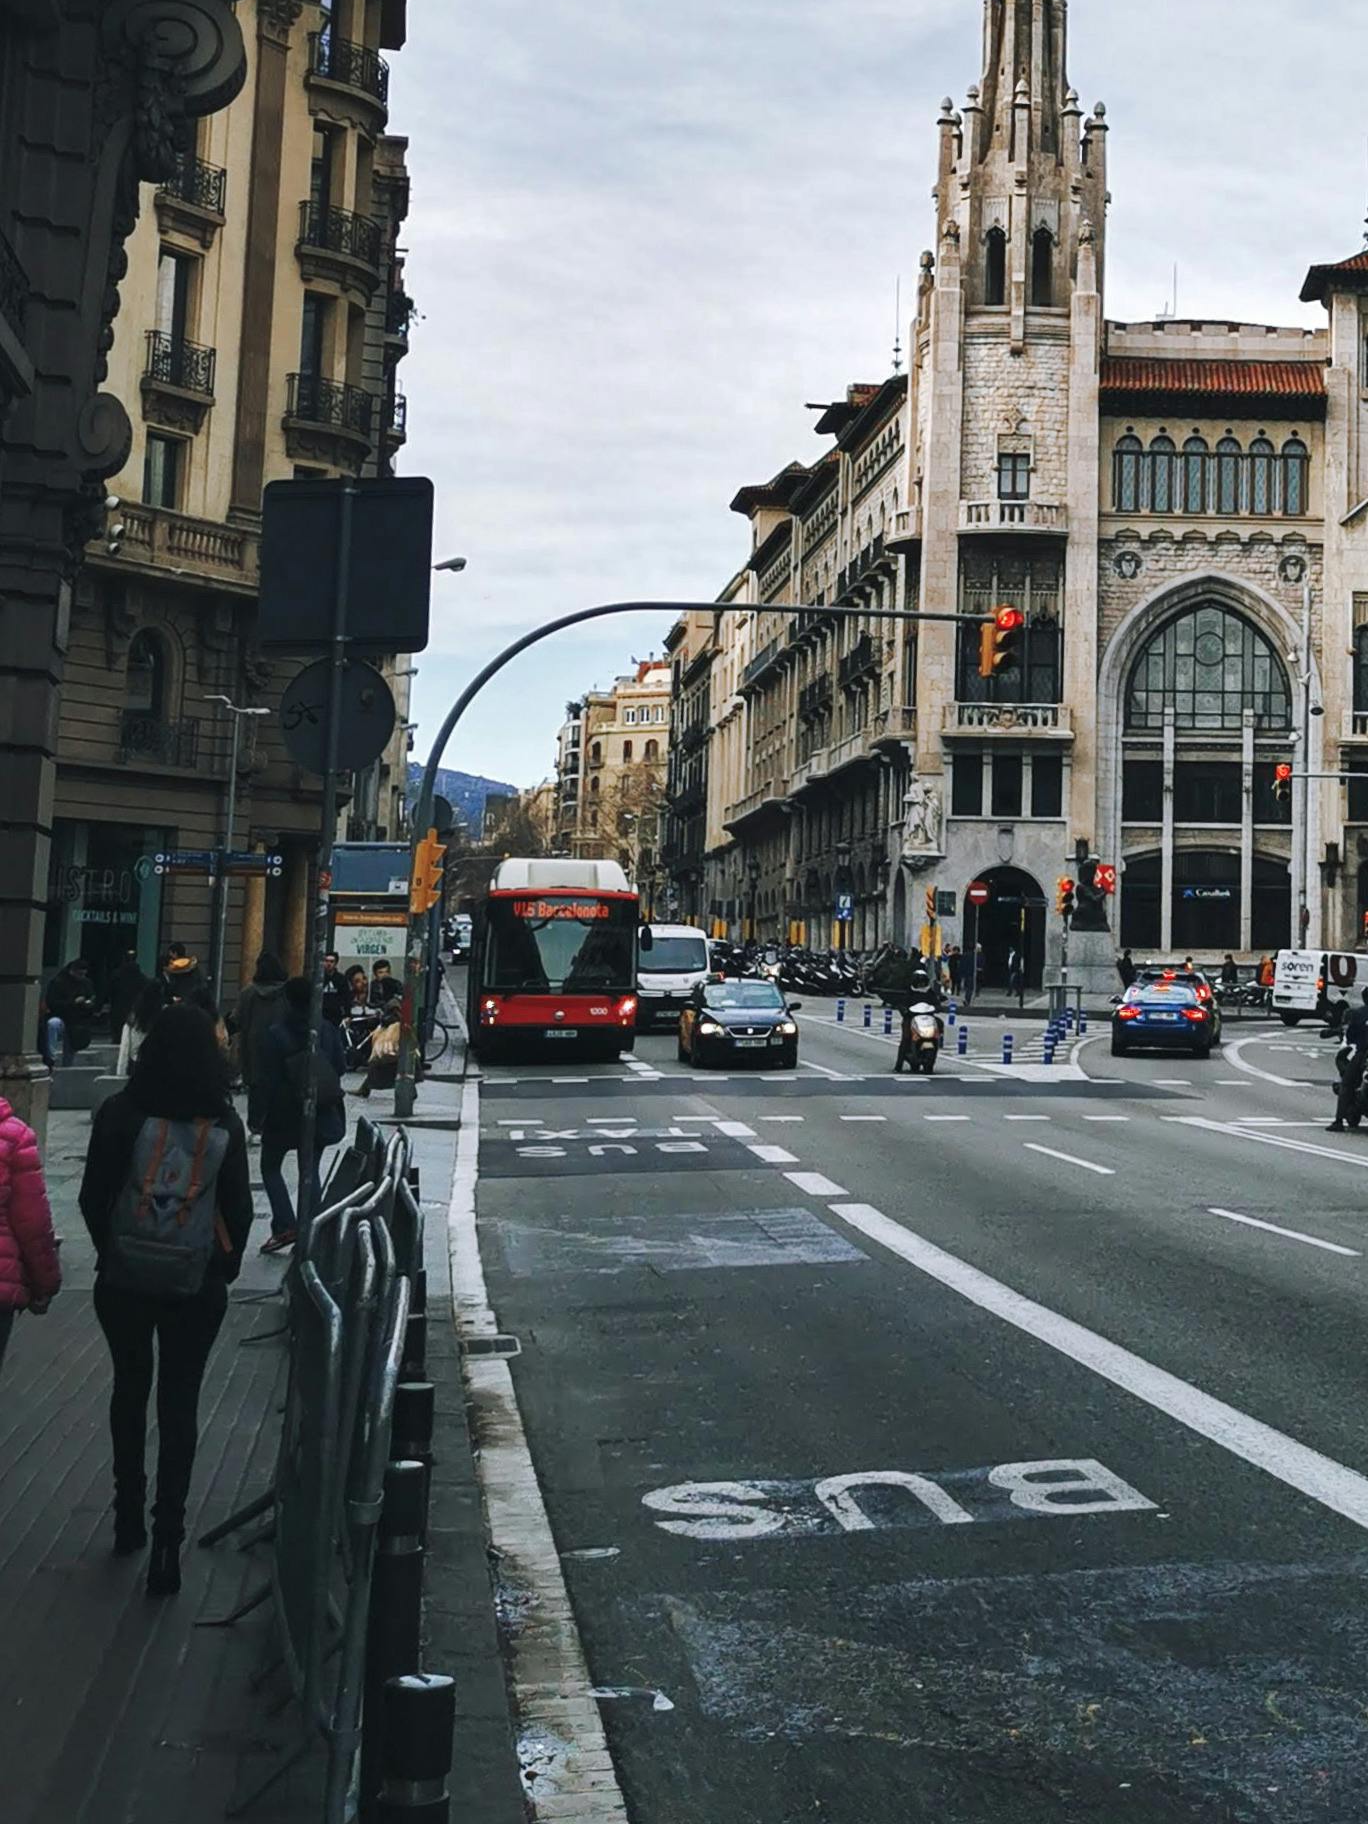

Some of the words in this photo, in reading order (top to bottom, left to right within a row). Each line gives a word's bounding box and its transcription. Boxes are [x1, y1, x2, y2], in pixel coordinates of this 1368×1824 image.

[509, 1127, 702, 1141] TAXI
[515, 1141, 710, 1158] BUS
[641, 1458, 1160, 1540] BUS
